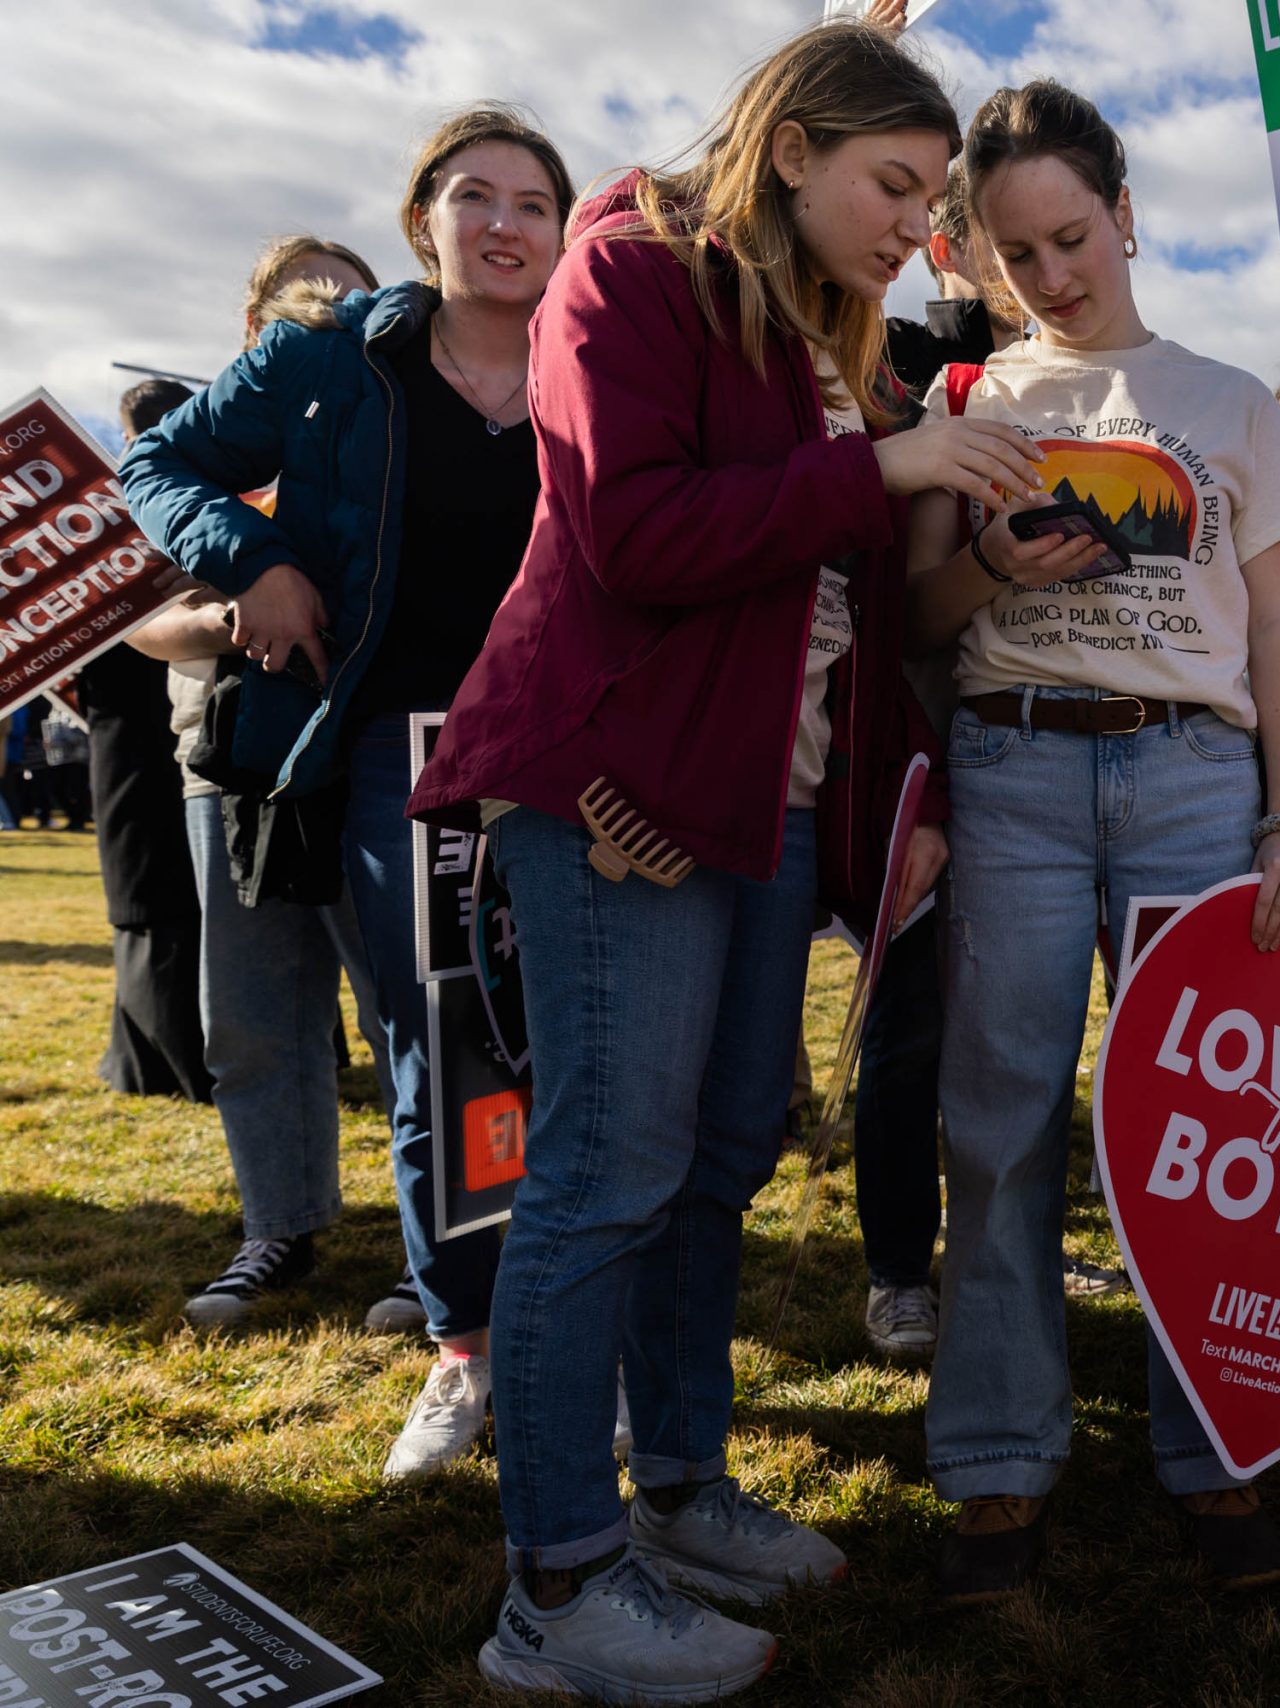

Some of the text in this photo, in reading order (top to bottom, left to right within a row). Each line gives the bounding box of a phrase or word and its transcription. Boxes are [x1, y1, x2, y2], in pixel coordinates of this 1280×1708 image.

[0, 459, 64, 527] ND
[1054, 417, 1219, 566] OF EVERY HUMAN BEING
[0, 478, 129, 599] CTION
[0, 538, 160, 664] NCEPTIO
[1067, 581, 1087, 595] OR
[1092, 581, 1152, 602] CHANCE,
[1159, 588, 1186, 602] BUT
[1070, 608, 1110, 626] PLAN
[1116, 608, 1140, 626] OF
[1147, 610, 1203, 634] GOD.
[23, 639, 74, 677] ACTION
[70, 627, 92, 643] TO
[91, 600, 133, 631] 53445
[1031, 631, 1064, 648] POPE
[1067, 628, 1136, 650] BENEDICT
[1208, 1282, 1271, 1335] LIVE
[1201, 1338, 1229, 1360] Text
[0, 1588, 193, 1708] POST-RO
[84, 1573, 289, 1707] I AM THE
[181, 1582, 312, 1670] STUDENTSFORLIFE.ORG
[504, 1604, 545, 1652] HOKA
